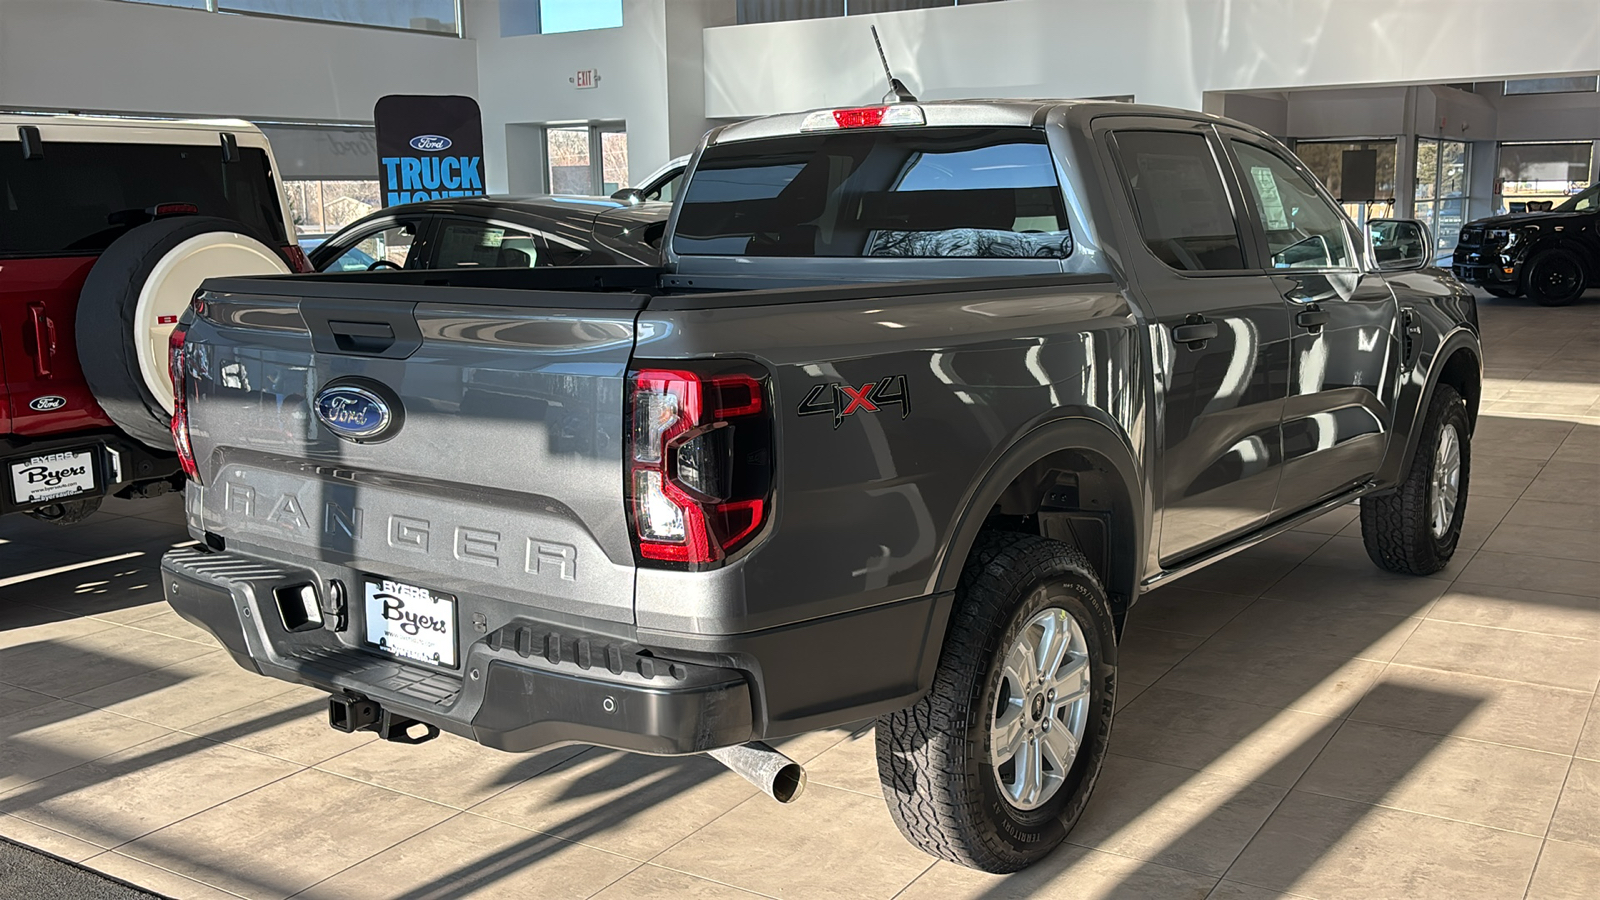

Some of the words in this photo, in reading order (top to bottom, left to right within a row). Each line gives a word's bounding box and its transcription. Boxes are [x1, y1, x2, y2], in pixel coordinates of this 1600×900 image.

[577, 70, 592, 87] EXIT
[417, 136, 444, 149] Ford
[382, 156, 482, 190] TRUCK
[37, 397, 60, 409] Ford
[328, 396, 368, 426] Ford
[30, 452, 73, 465] BYERS
[18, 465, 86, 486] Byers
[224, 480, 578, 582] RANGER
[382, 580, 430, 600] BYERS
[373, 593, 446, 635] Byers
[1001, 819, 1041, 843] TERRITORY
